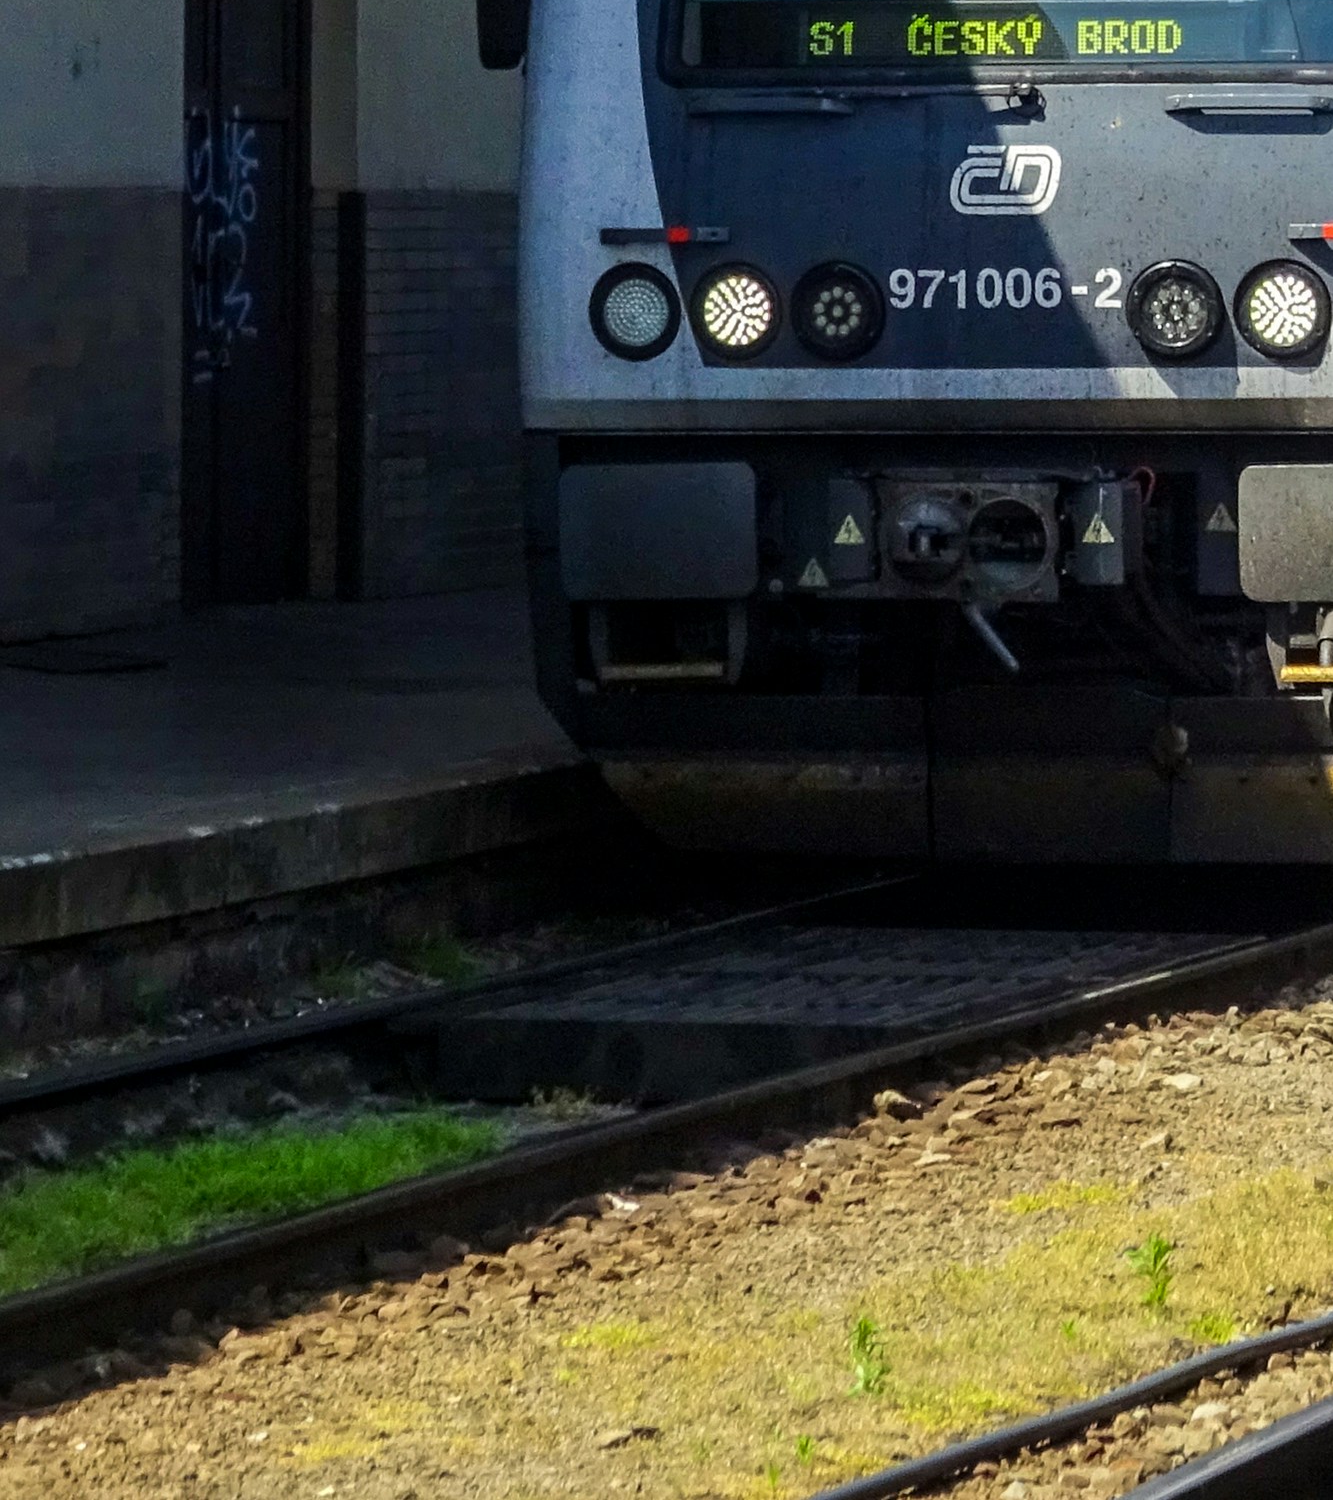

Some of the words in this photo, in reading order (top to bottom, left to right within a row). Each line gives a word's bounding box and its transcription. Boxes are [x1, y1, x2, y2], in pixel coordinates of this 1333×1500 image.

[809, 20, 855, 56] S1
[906, 14, 1043, 56] ČESKÝ
[1077, 19, 1182, 55] BROD
